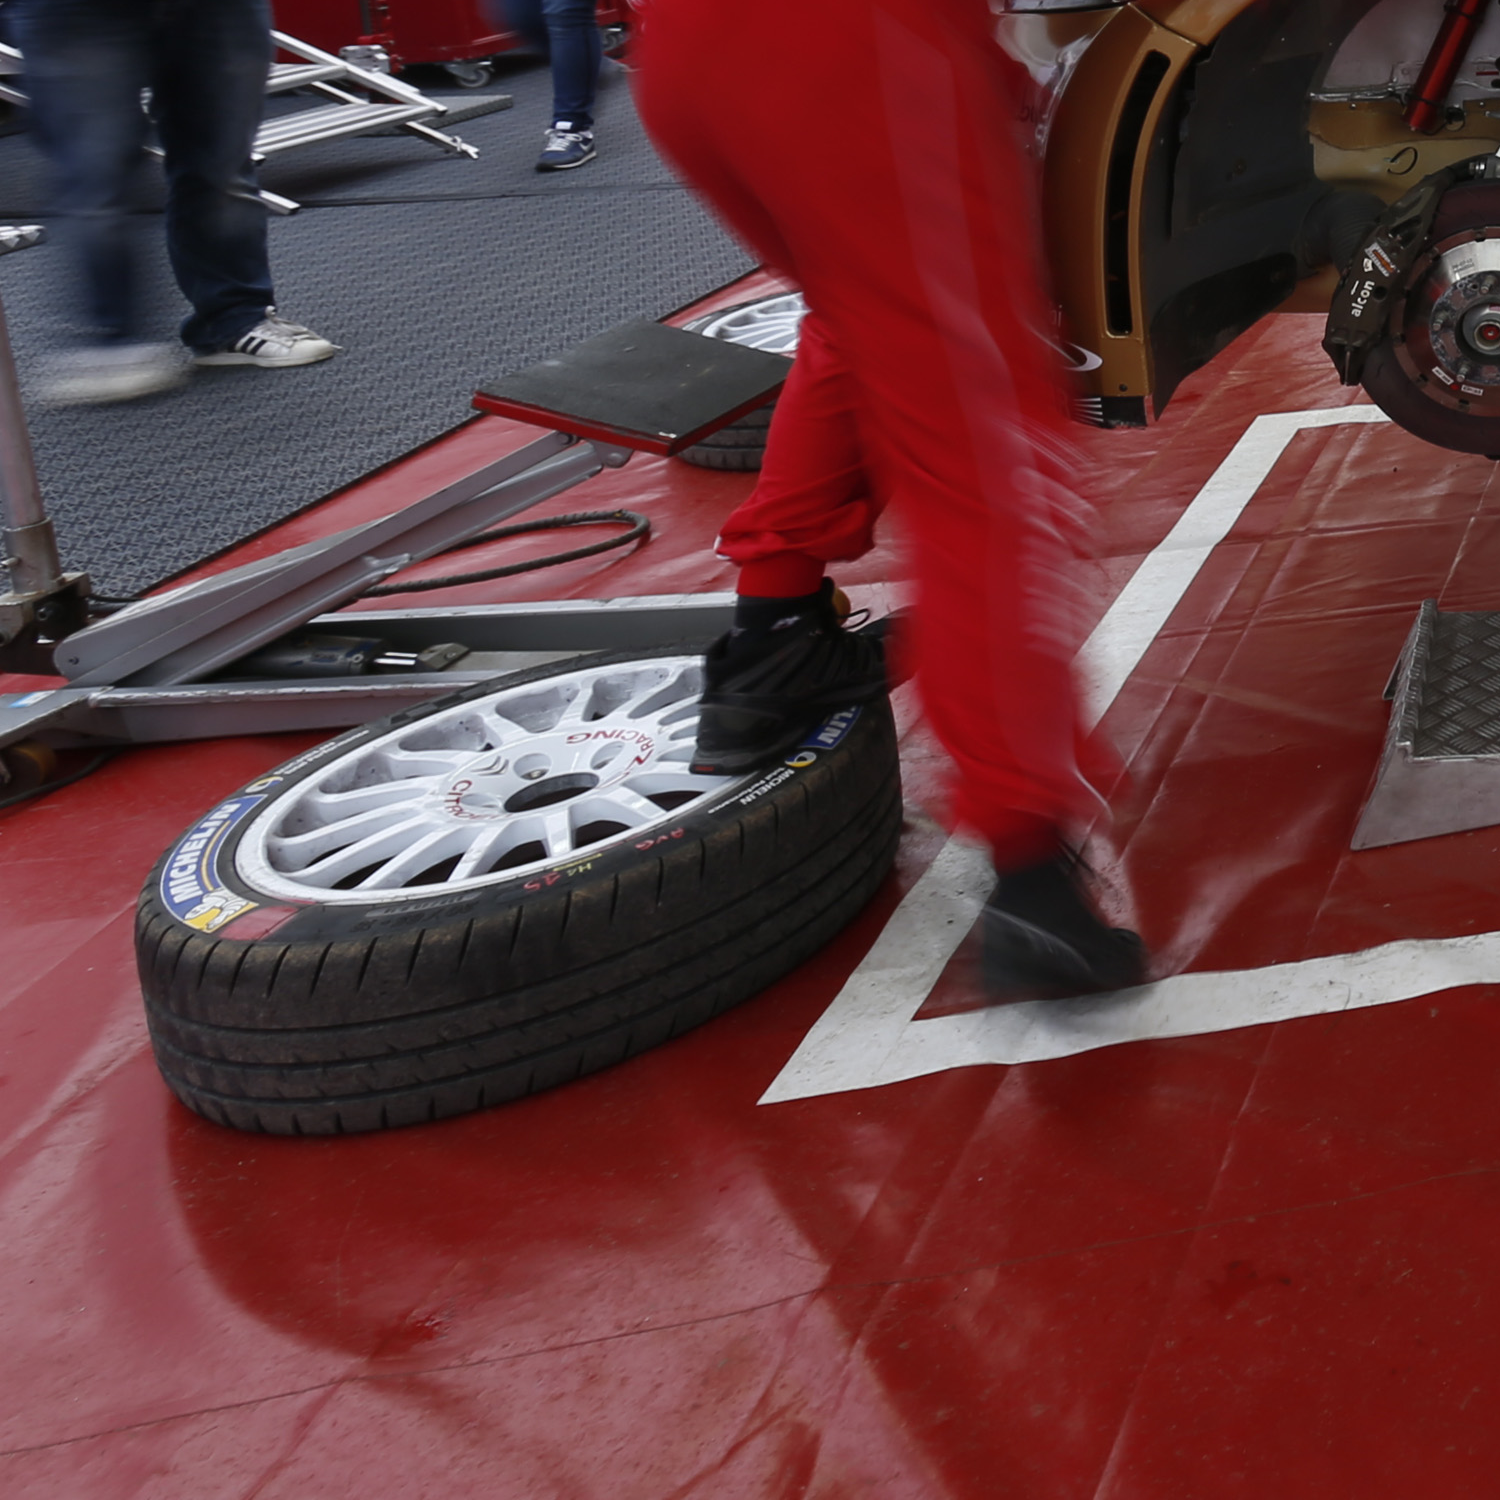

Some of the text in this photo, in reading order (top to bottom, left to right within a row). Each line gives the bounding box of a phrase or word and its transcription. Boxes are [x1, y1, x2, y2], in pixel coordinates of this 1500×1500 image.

[1351, 280, 1375, 318] alcon
[739, 767, 795, 806] MICHELIN
[168, 802, 242, 904] MICHELIN
